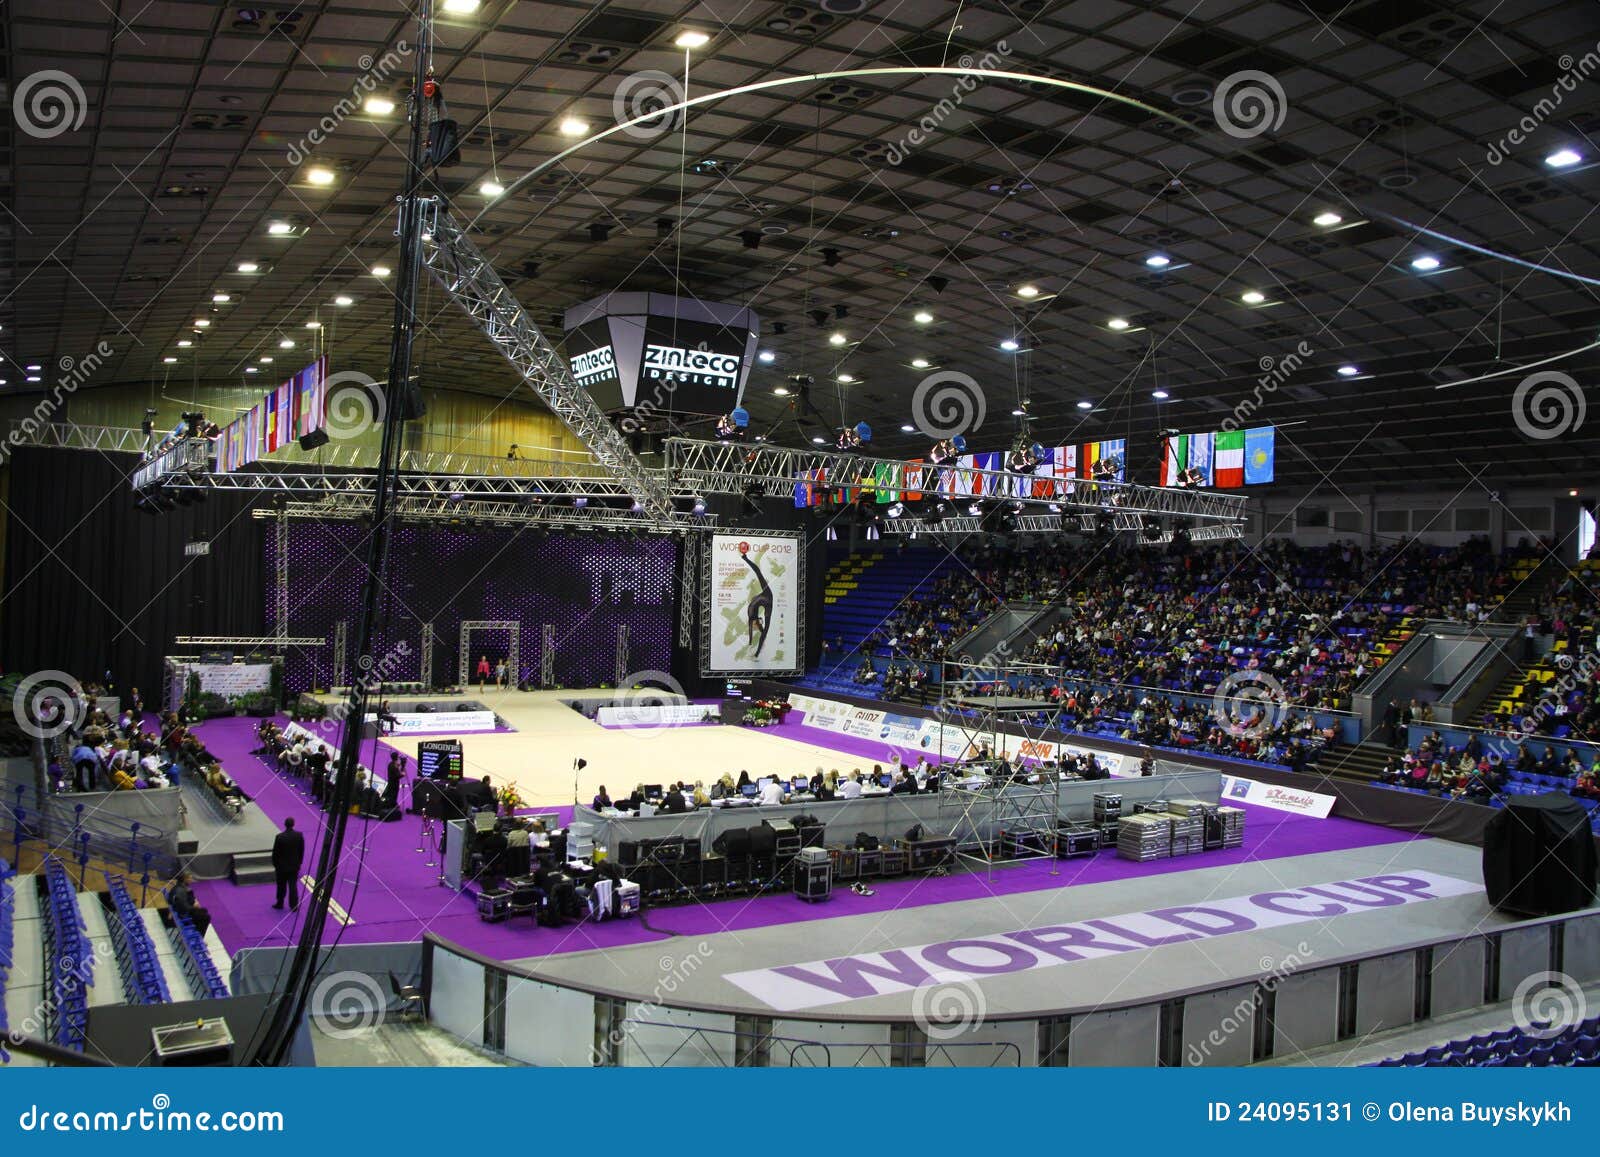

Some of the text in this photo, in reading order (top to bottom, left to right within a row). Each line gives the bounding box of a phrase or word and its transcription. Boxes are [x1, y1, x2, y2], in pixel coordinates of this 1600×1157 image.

[651, 369, 728, 387] DESIGN
[771, 544, 792, 554] 2012
[423, 742, 460, 752] LONGINES
[776, 870, 1440, 998] WORLD CUP
